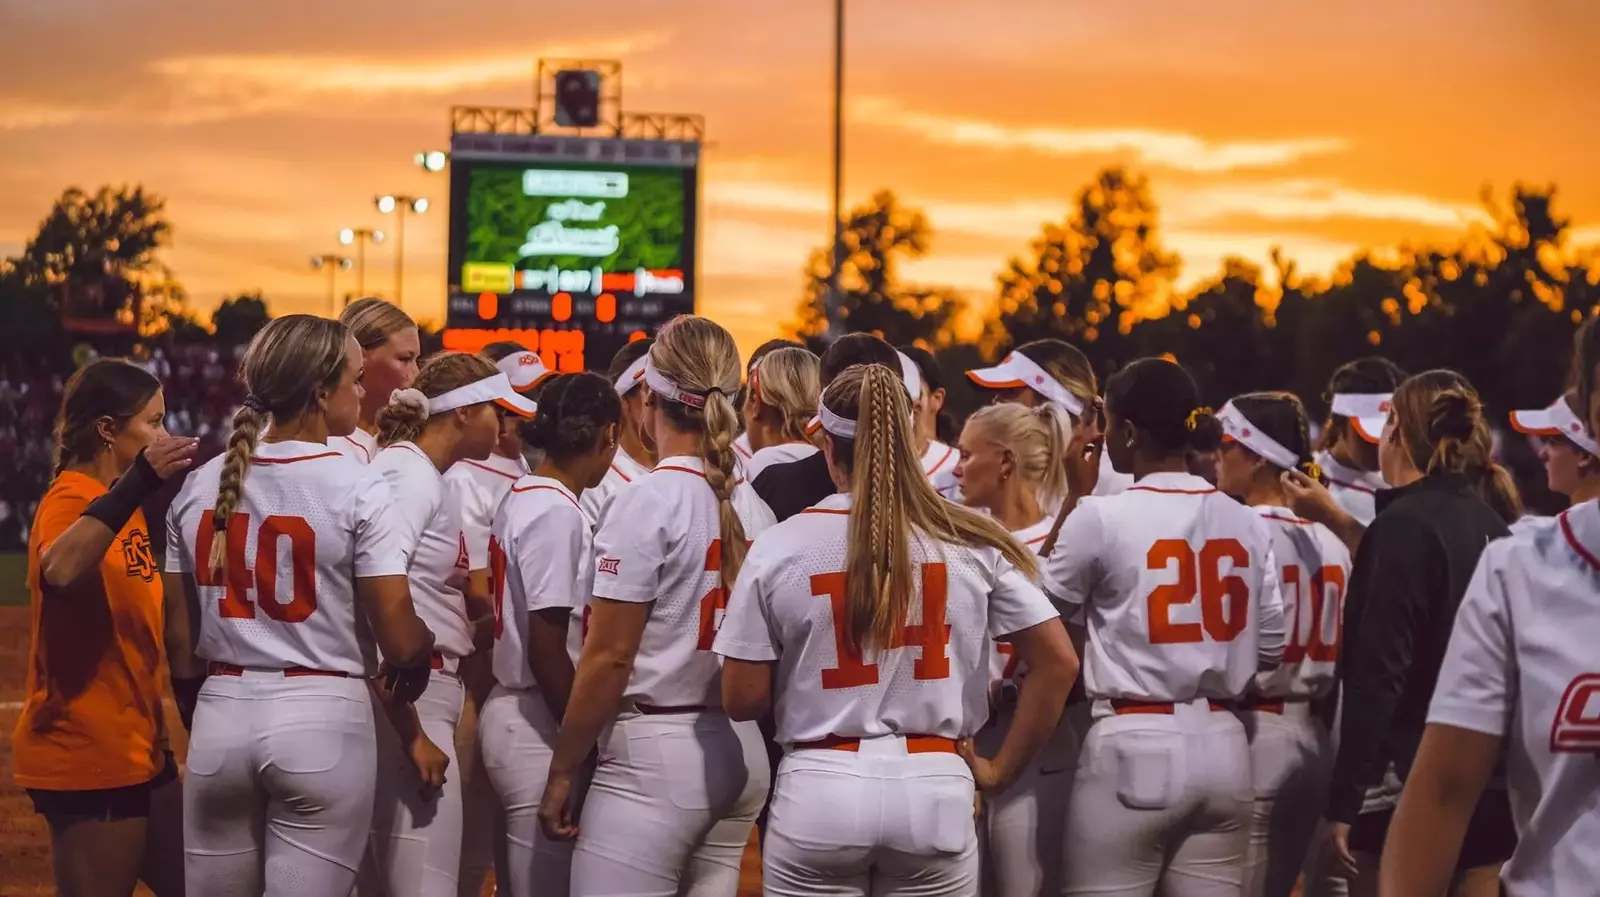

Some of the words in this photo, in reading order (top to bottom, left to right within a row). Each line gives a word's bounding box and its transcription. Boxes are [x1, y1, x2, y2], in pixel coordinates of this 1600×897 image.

[195, 509, 318, 623] 40
[1147, 538, 1249, 644] 26
[1282, 565, 1345, 662] 10
[810, 562, 952, 689] 14
